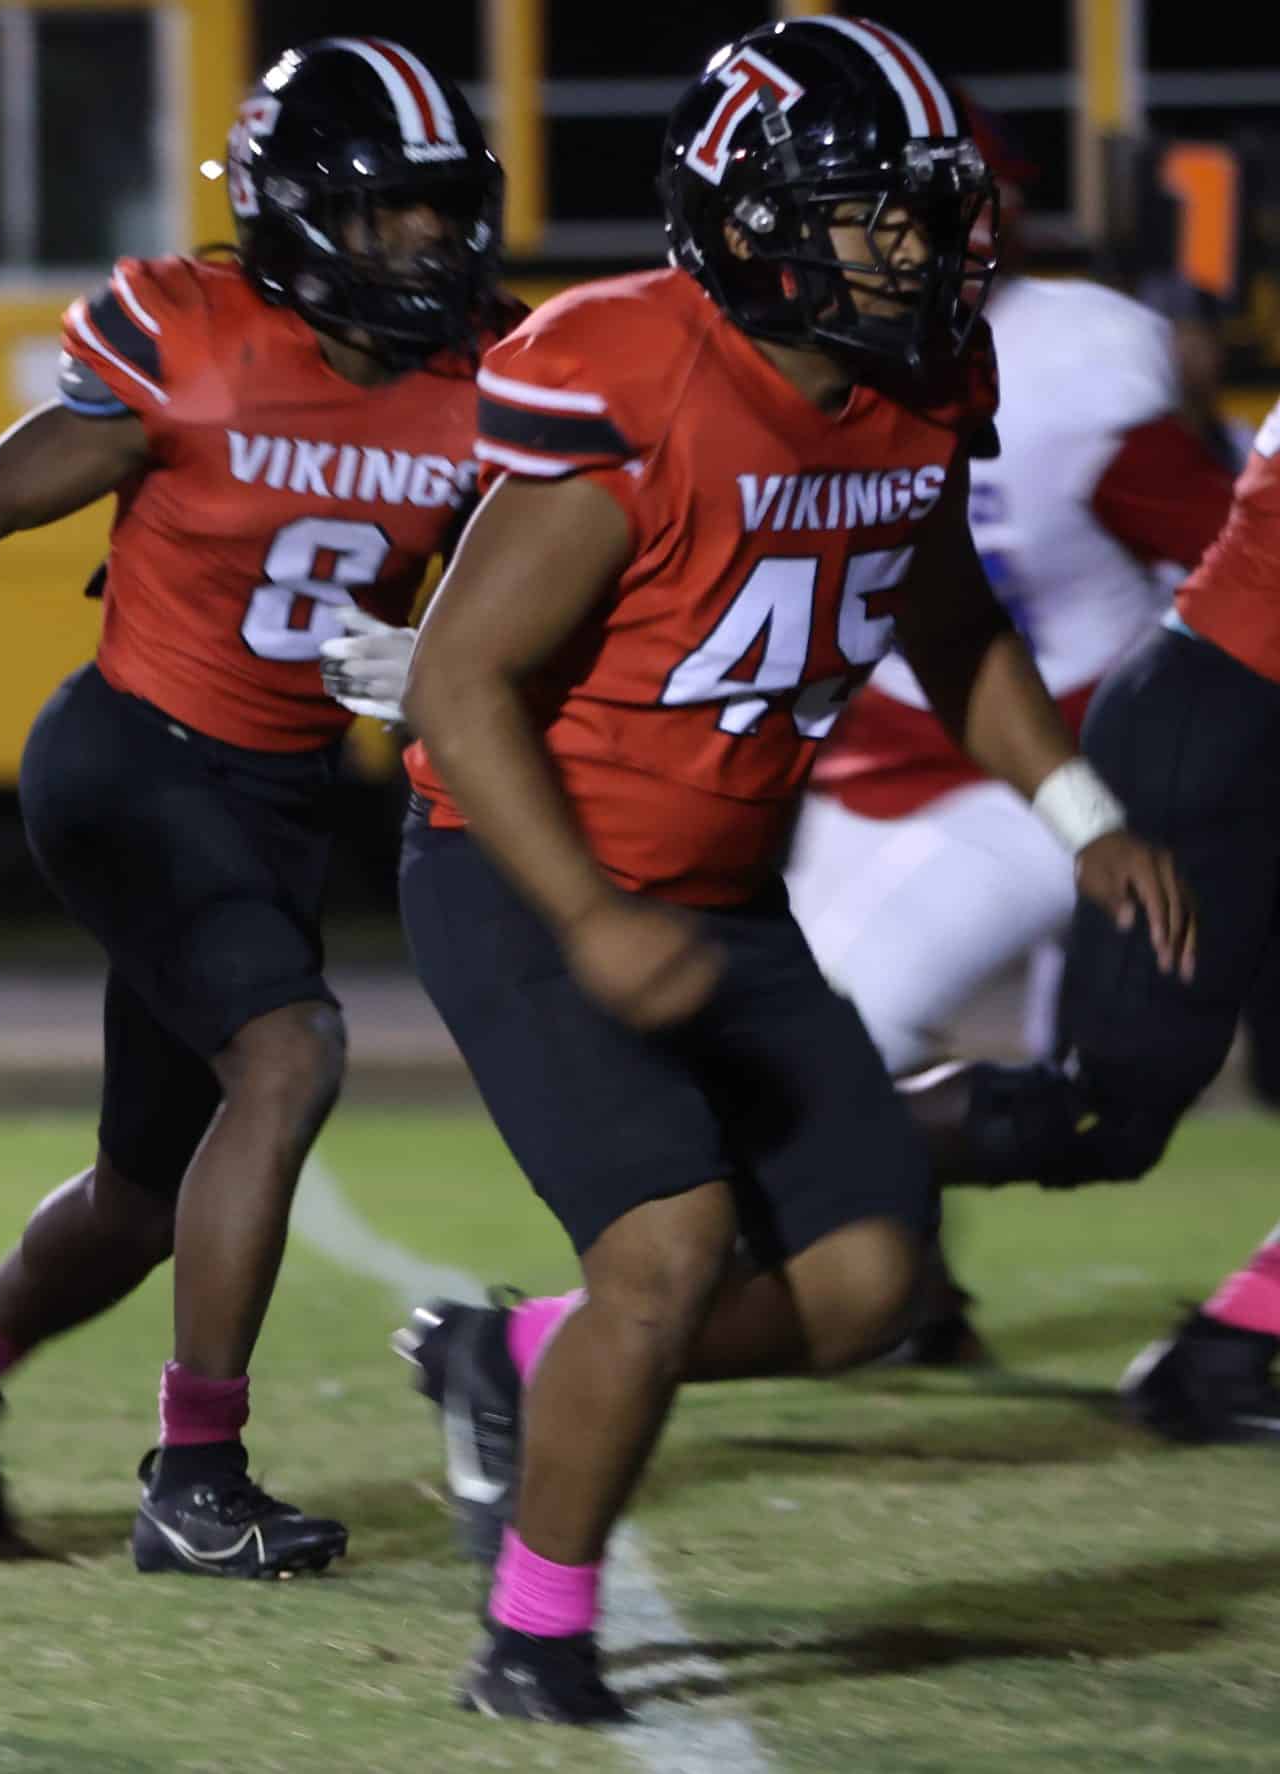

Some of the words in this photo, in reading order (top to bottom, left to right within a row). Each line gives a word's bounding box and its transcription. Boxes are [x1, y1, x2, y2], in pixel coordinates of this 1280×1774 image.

[686, 46, 805, 186] T
[736, 465, 946, 533] VIKINGS
[659, 545, 916, 739] 45
